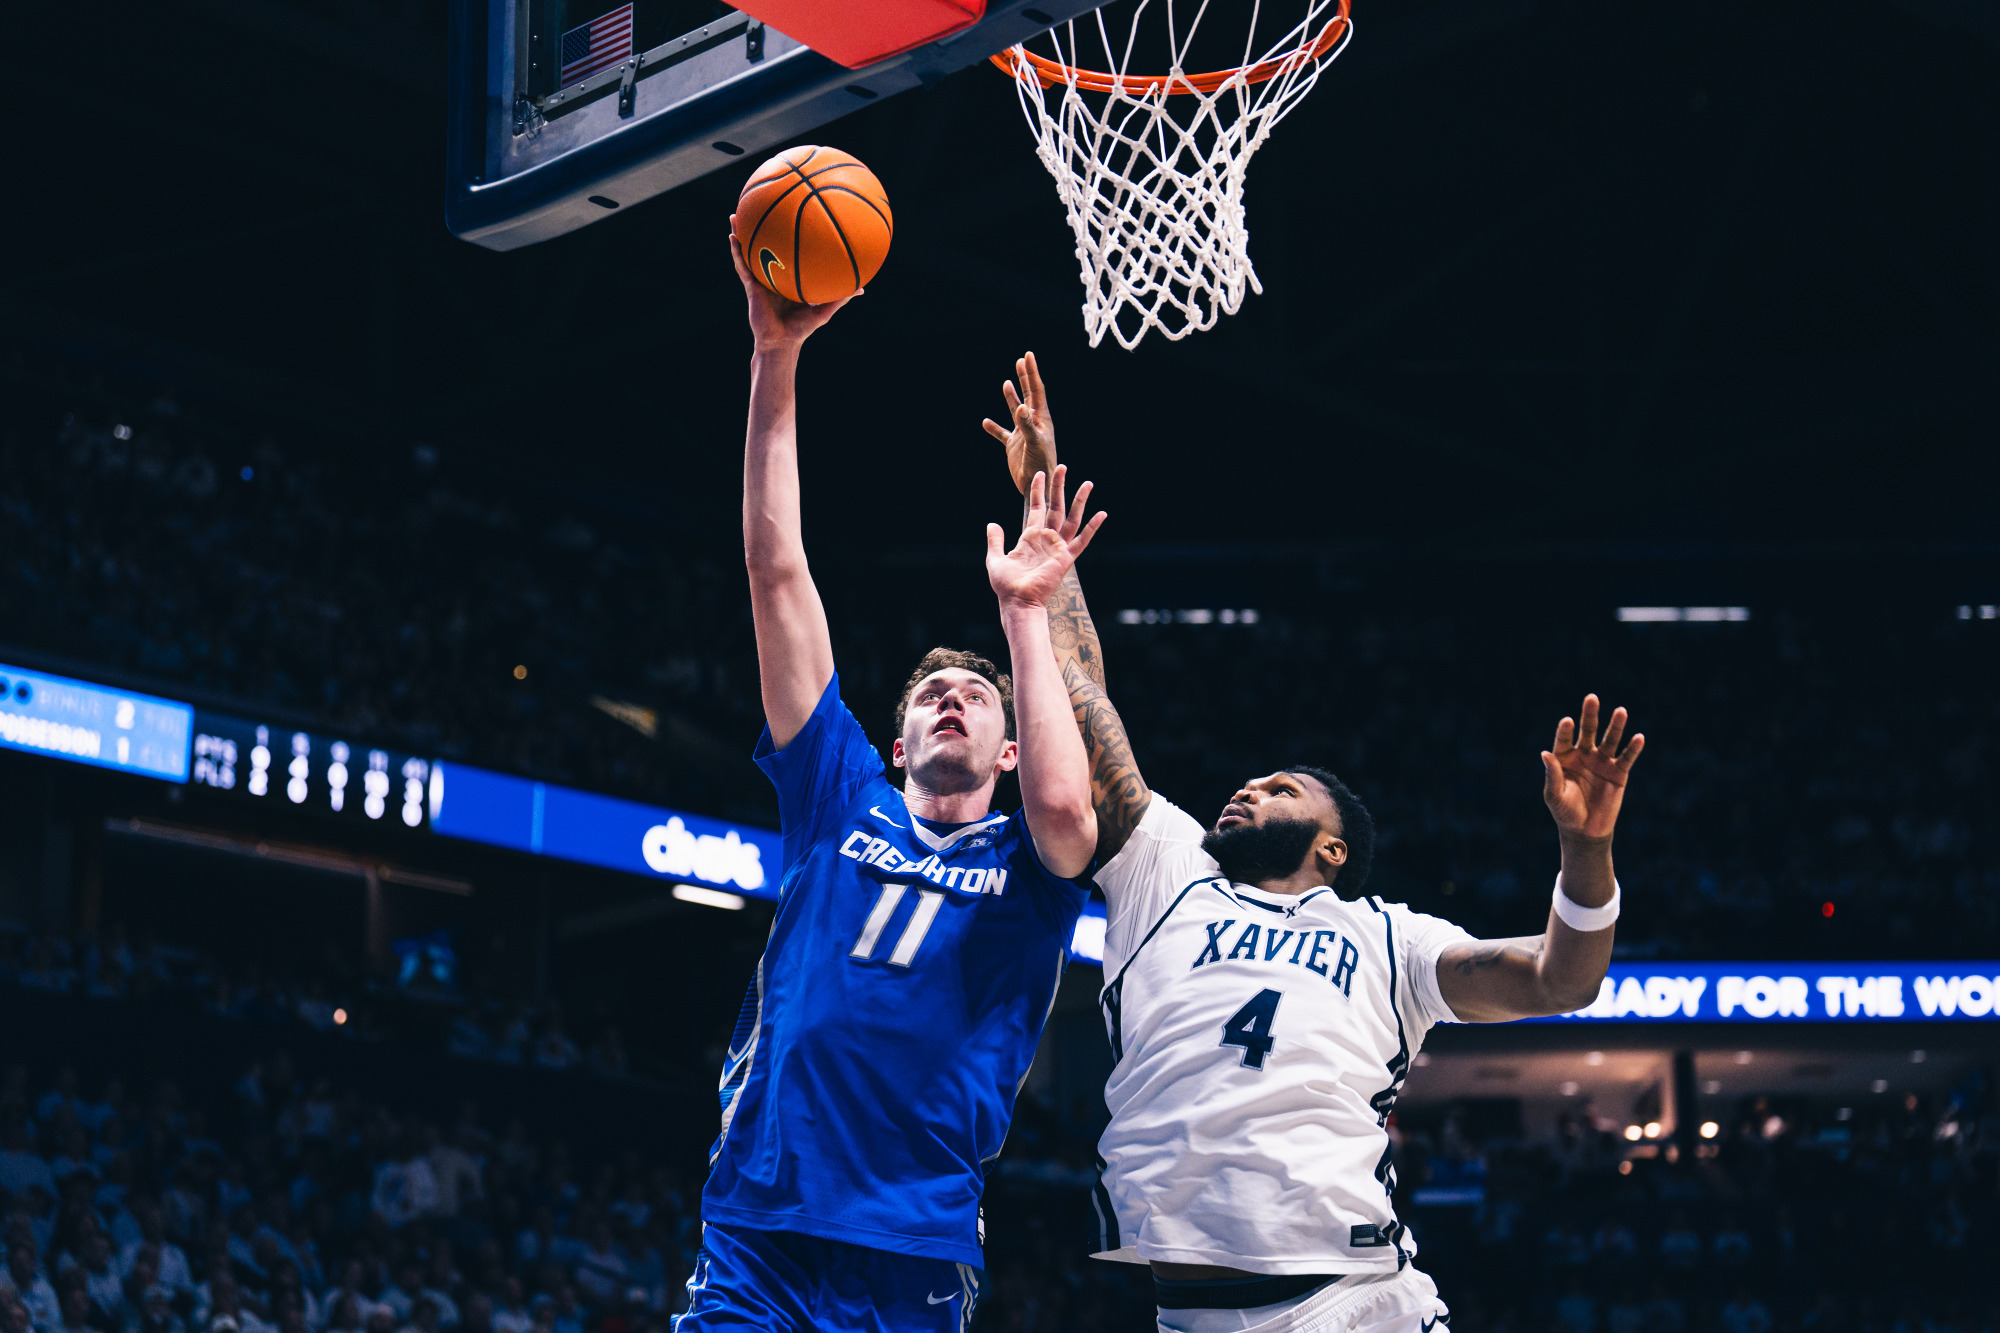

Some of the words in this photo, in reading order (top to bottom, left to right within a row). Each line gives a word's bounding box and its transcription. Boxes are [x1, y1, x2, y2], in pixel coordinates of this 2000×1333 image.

[849, 883, 946, 968] 11
[1190, 919, 1359, 1002] XAVIER
[1219, 987, 1285, 1072] 4
[1716, 976, 1809, 1018] FOR
[1817, 976, 1905, 1018] THE
[1913, 975, 2000, 1018] WO
